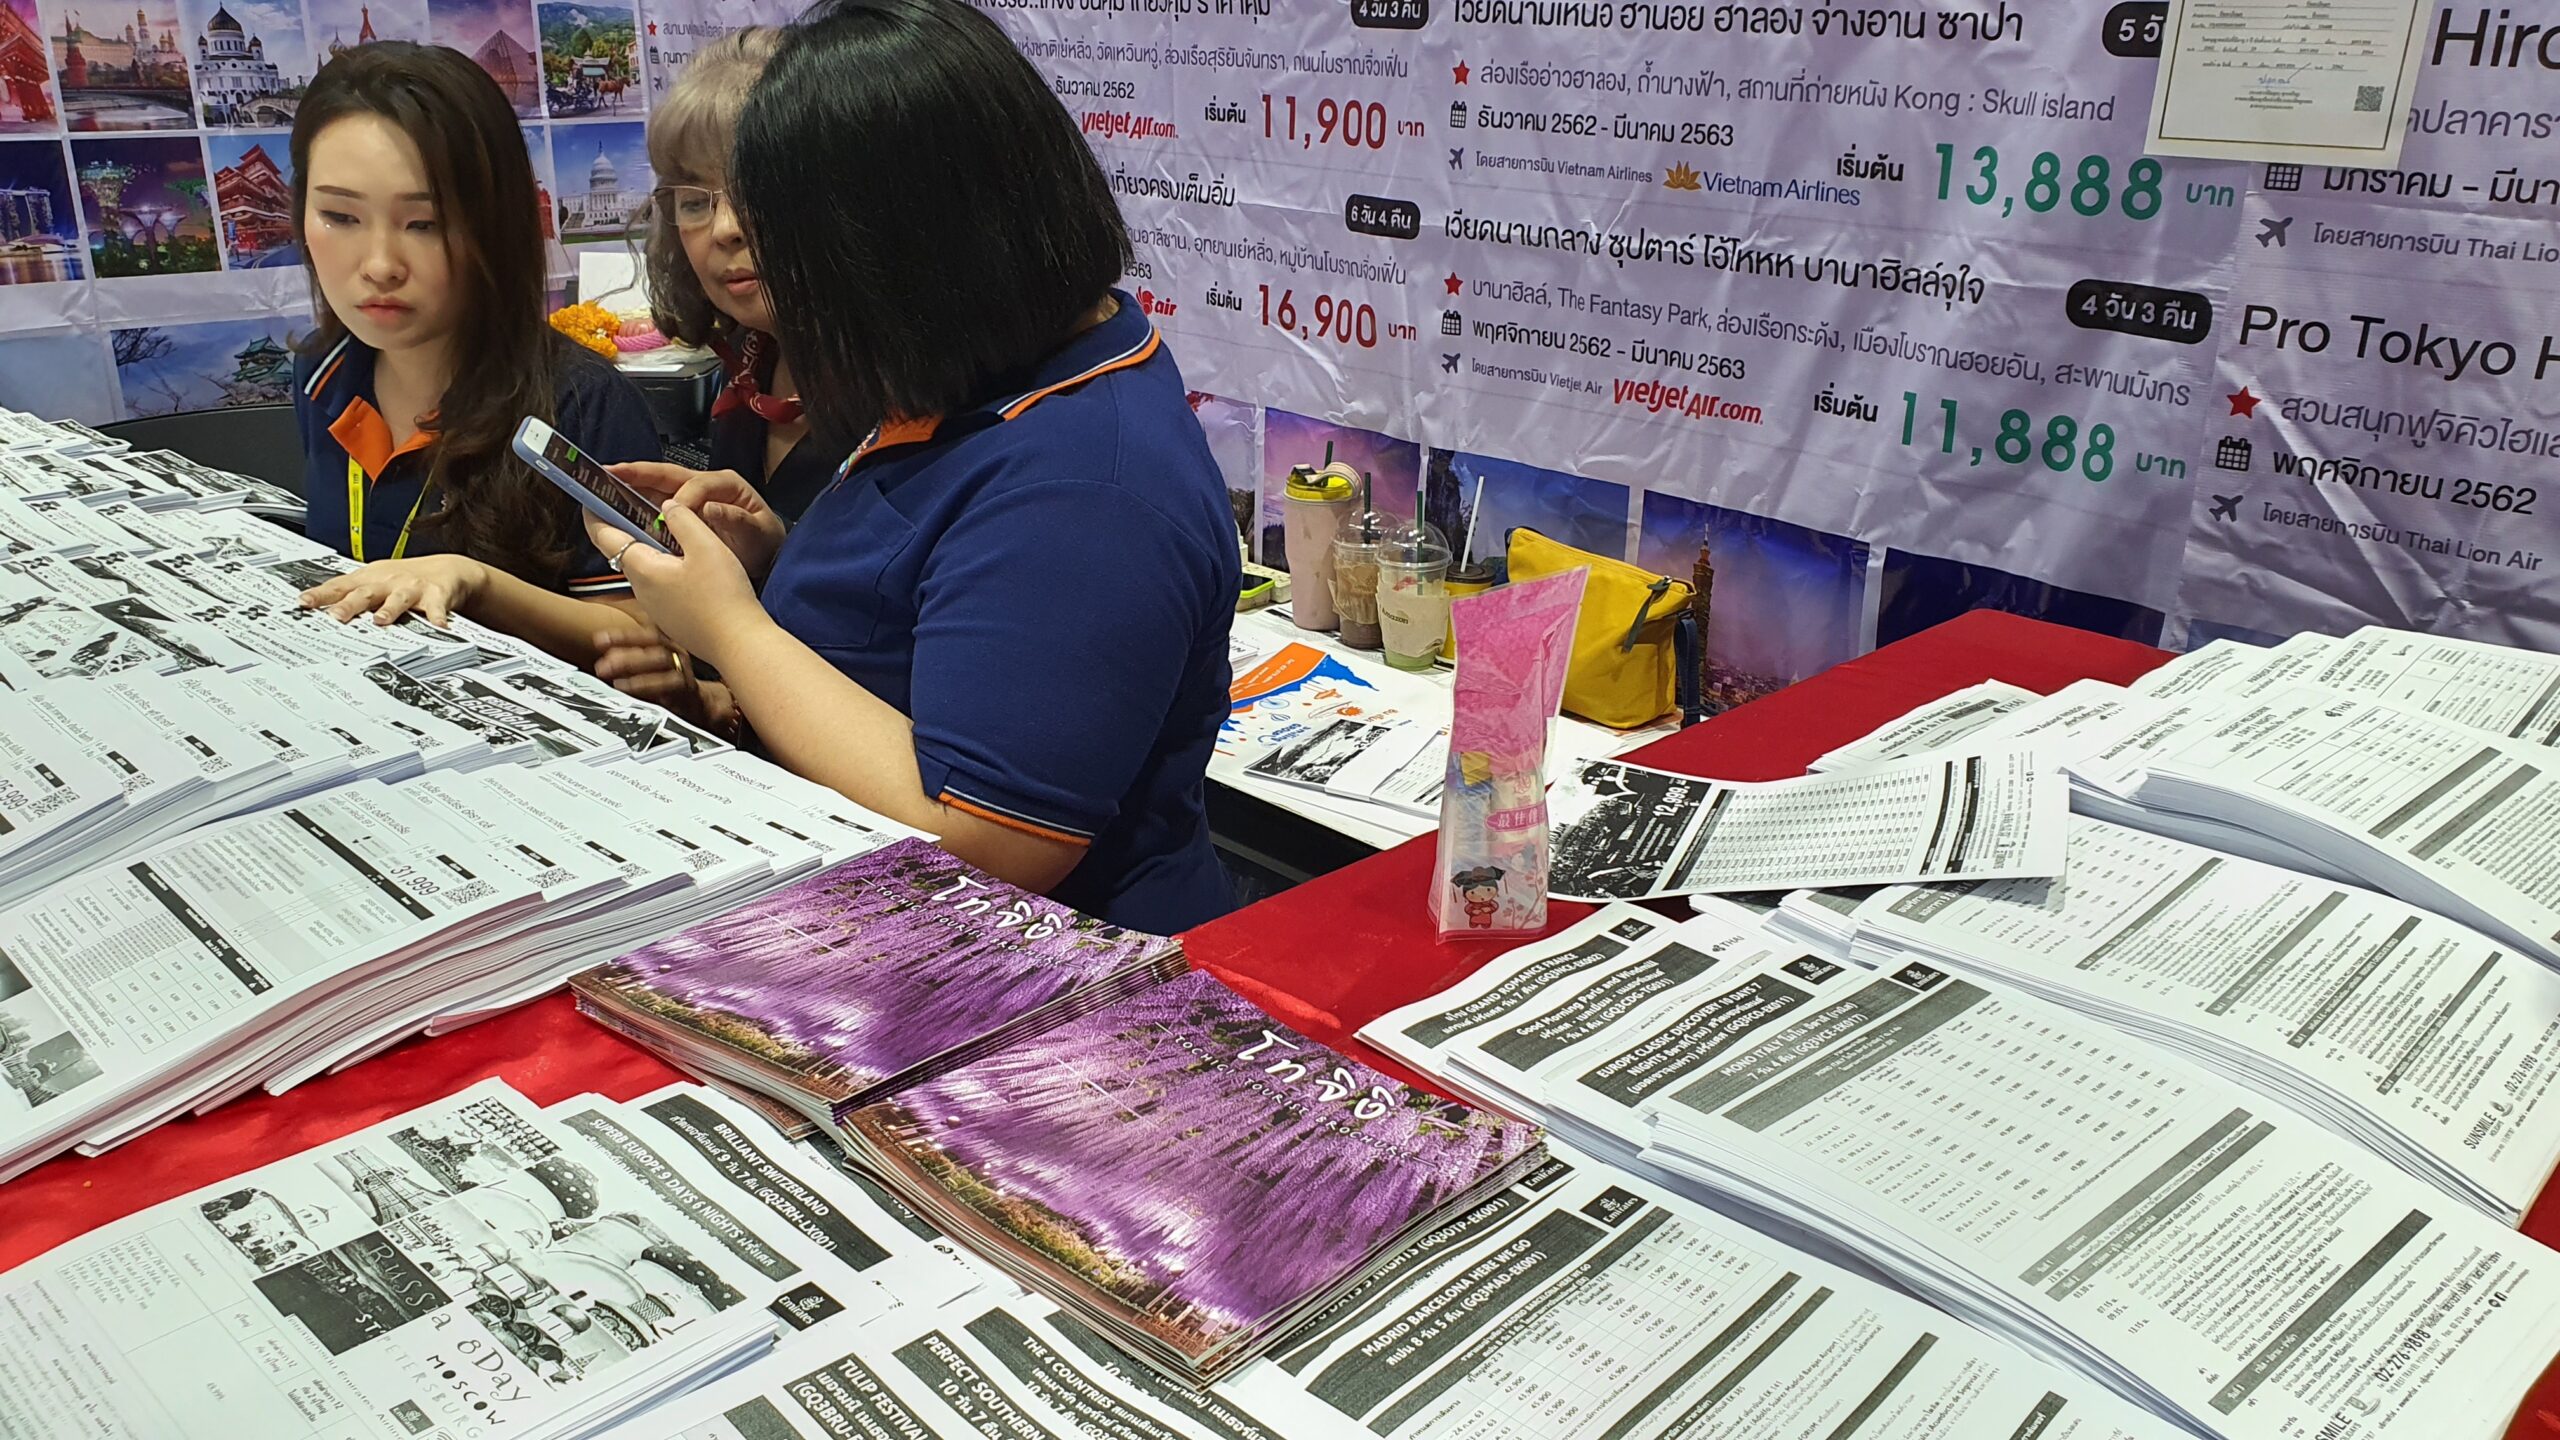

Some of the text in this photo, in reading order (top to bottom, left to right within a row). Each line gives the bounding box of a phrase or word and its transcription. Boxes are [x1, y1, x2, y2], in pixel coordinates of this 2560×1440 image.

[1359, 2, 1369, 18] 4
[1390, 3, 1400, 19] 3
[1619, 1, 2024, 42] ฮานอย ฮาลอง ซาปา
[2118, 19, 2137, 42] 5
[1055, 75, 1135, 99] ธันวาคม 2562
[1480, 59, 1631, 96] ล่องเรืออ่าวฮาลอง,
[1637, 60, 1732, 101] ถ้ำนางฟ้า,
[1737, 68, 1887, 108] สถานที่ถ่ายหนัง
[1894, 85, 1961, 117] Kong
[1982, 90, 2035, 115] Skull
[2041, 95, 2116, 121] island
[1204, 93, 1425, 150] เริ่มต้น 11,900 บาท
[1477, 104, 1547, 132] ธันวาคม
[1551, 112, 1598, 136] 2562
[1613, 113, 1675, 143] มีนาคม
[1680, 121, 1735, 147] 2563
[1476, 150, 1654, 184] โดยสายการบิน Vietnam Airlines
[1703, 171, 1861, 207] Vietnam Airlines
[1835, 142, 2236, 221] เริ่มต้น 13,888 บาท
[1351, 206, 1412, 230] 6 วัน 4 คืน
[1444, 208, 1601, 256] เวียดนามกลาง
[1607, 227, 1697, 270] ซุปตาร์
[1803, 255, 1986, 312] บานาฮิลล์จุใจ
[2313, 222, 2460, 257] โดยสายการบิน
[2466, 237, 2517, 262] Thai
[1206, 281, 1417, 349] เริ่มต้น 16,900 บาท
[2080, 292, 2198, 332] 4 วัน 3 คืน
[1472, 278, 2192, 408] บานาฮิลล์, The Fantasy Park, ล่องเรือกระด้ง, เมืองโบราณฮอยอัน, สะพานมังกร
[1472, 318, 1747, 381] พฤศจิกายน 2562 มีนาคม 2563
[2239, 304, 2518, 382] Pro Tokyo
[1471, 356, 1604, 396] โดยสายการบิน Vietjet Air
[1812, 382, 2188, 484] เริ่มต้น 11,888 บาท
[2272, 450, 2538, 516] พฤศจิกายน 2562
[2262, 500, 2544, 571] โดยสายการบิน Thai Lion Air
[453, 699, 540, 733] GEORGIA
[389, 864, 440, 896] 31,999
[1719, 934, 1745, 951] THAI
[1464, 946, 1578, 1013] GRAND ROMANCE FRANCE
[1515, 952, 1659, 1036] Good Morning Paris and Windmill
[1595, 981, 1762, 1078] EUROPE CLASSIC DISCOVERY DAYS 7
[1174, 1034, 1235, 1077] TOCHIGI
[1244, 1077, 1310, 1116] TOURIST
[1626, 1051, 1667, 1076] NIGHTS
[1719, 1038, 1783, 1076] MONO ITALY
[2503, 1053, 2538, 1093] 02-276-9898
[2462, 1111, 2497, 1150] SUNSMILE
[713, 1122, 765, 1169] BRILLIANT
[759, 1157, 829, 1216] SWITZERLAND
[1522, 1160, 1565, 1188] Emirates
[589, 1118, 775, 1267] SUPERB EUROPE 9 DAYS 6 NIGHTS ฝรั่งเศส
[716, 1149, 836, 1257] 9 วัน 7 คืน (GQ3ZRH-LX001)
[1602, 1195, 1640, 1225] Emirates
[777, 1291, 815, 1328] Emirates
[1360, 1238, 1531, 1356] MADRID BARCELONA HERE WE GO
[1385, 1250, 1546, 1366] สเปน 8 วัน 5 คืน (GQ3MAD-EK001)
[837, 1358, 876, 1392] TULIP
[922, 1335, 976, 1382] PERFECT
[1022, 1335, 1115, 1408] THE 4 COUNTRIES
[2373, 1326, 2431, 1382] 02-276-9898
[937, 1377, 959, 1396] 10
[953, 1393, 973, 1414] วัน
[969, 1409, 987, 1422] 7
